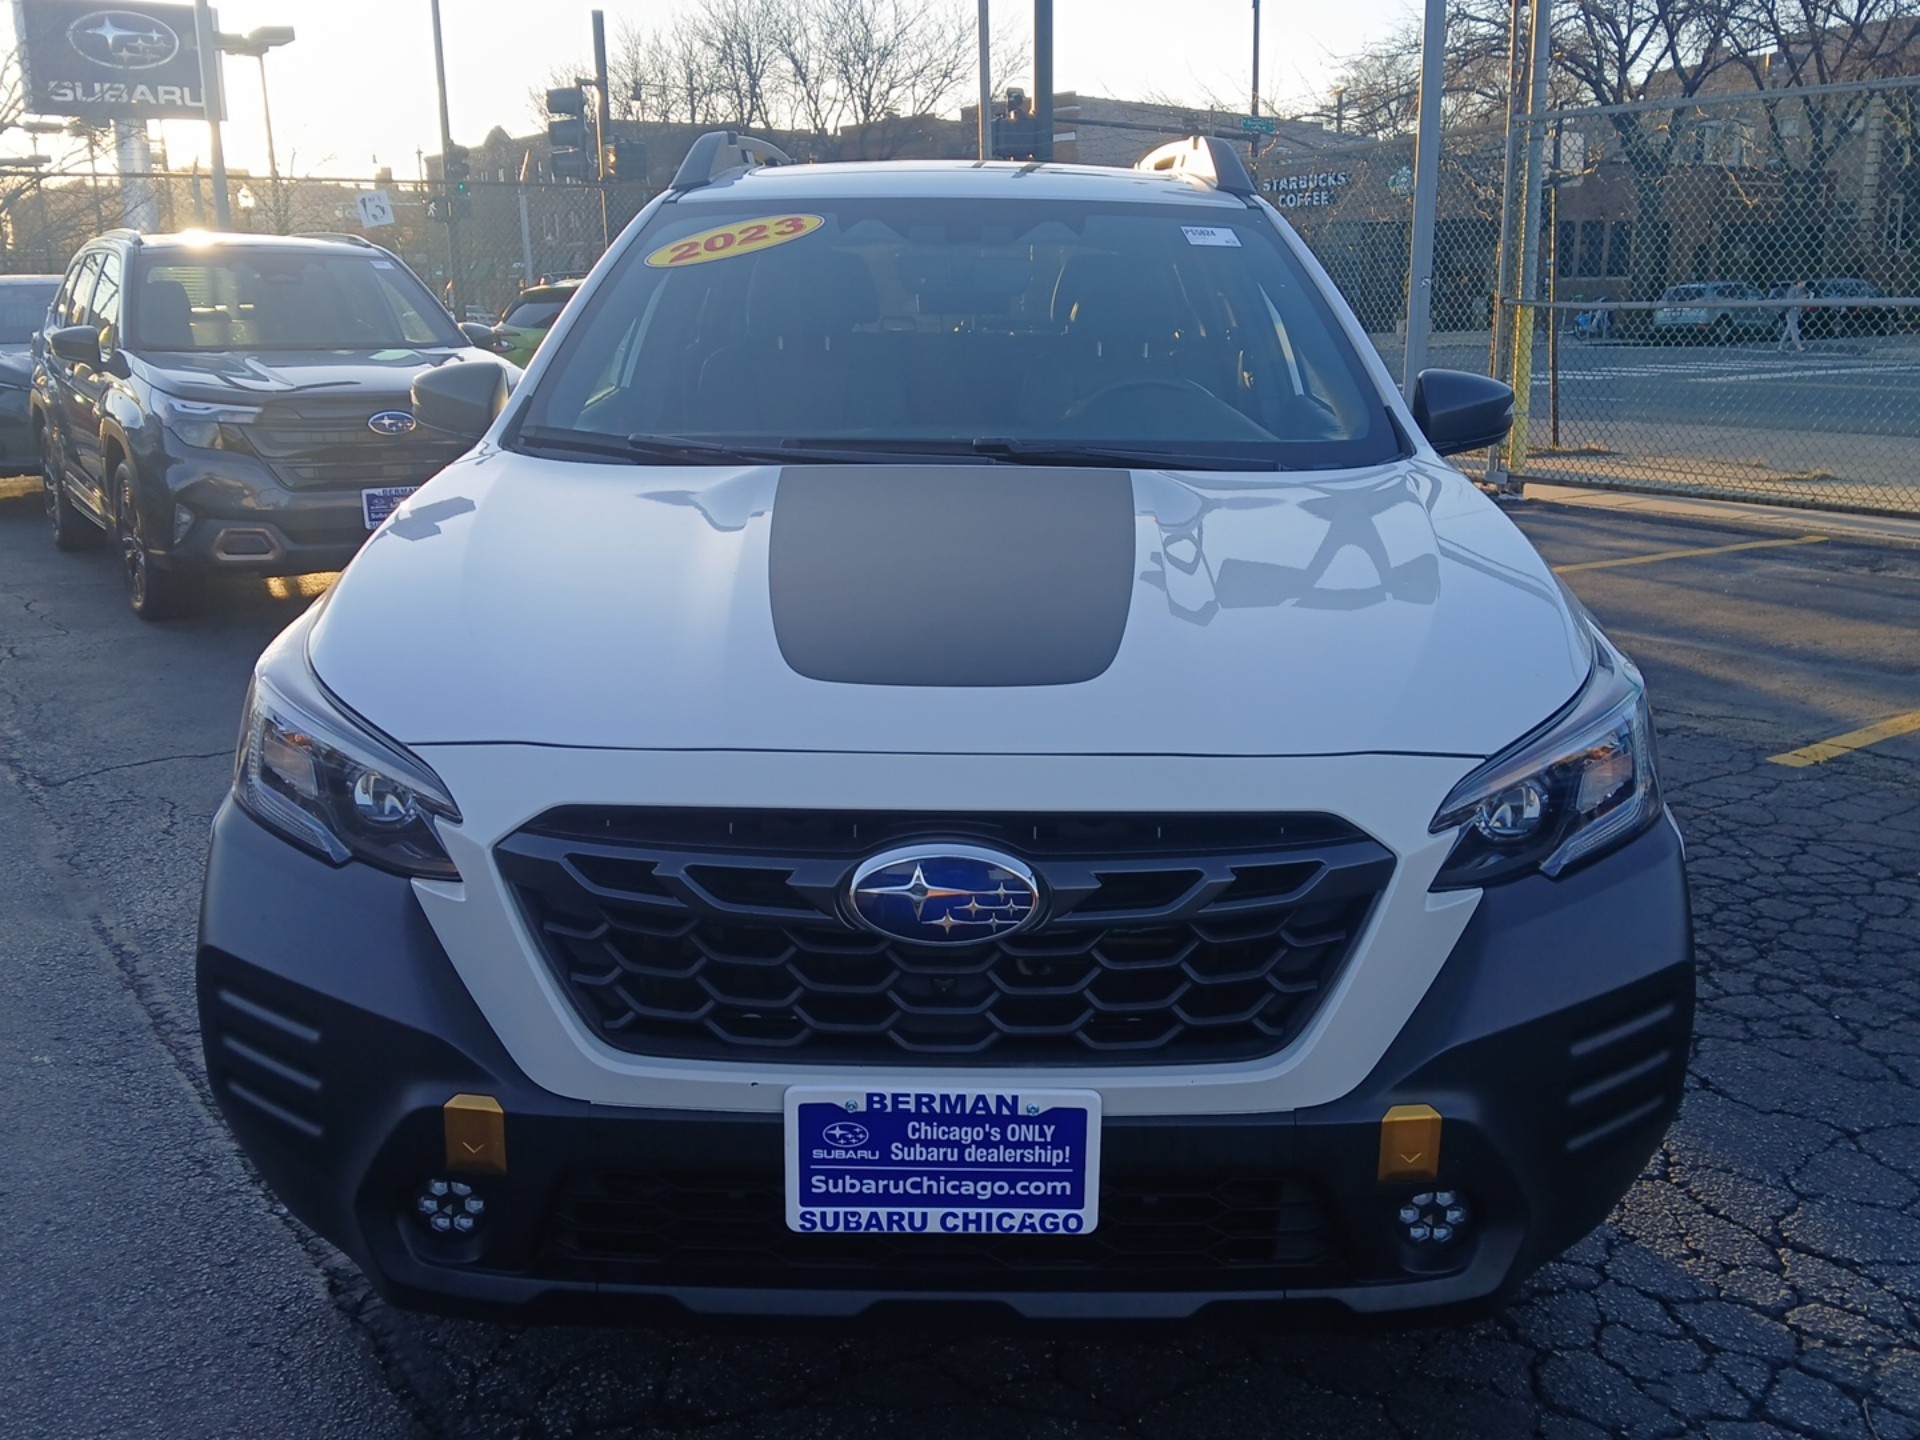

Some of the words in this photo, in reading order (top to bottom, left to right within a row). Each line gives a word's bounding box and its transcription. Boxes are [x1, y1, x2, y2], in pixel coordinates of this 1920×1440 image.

[48, 80, 205, 107] SUBARU
[1263, 171, 1347, 192] STARBUCKS
[1279, 190, 1329, 208] COFFEE
[668, 216, 807, 264] 2023
[382, 487, 420, 496] BERMA
[865, 1092, 1020, 1116] BERMAN
[907, 1121, 1001, 1145] Chicago's
[1006, 1125, 1056, 1142] ONLY
[812, 1149, 880, 1160] SUBARU
[890, 1143, 959, 1162] Subaru
[964, 1145, 1071, 1166] dealership!
[810, 1175, 1072, 1200] SubaruChicago.com
[799, 1211, 929, 1232] SUBARU
[939, 1212, 1084, 1233] CHICAGO
